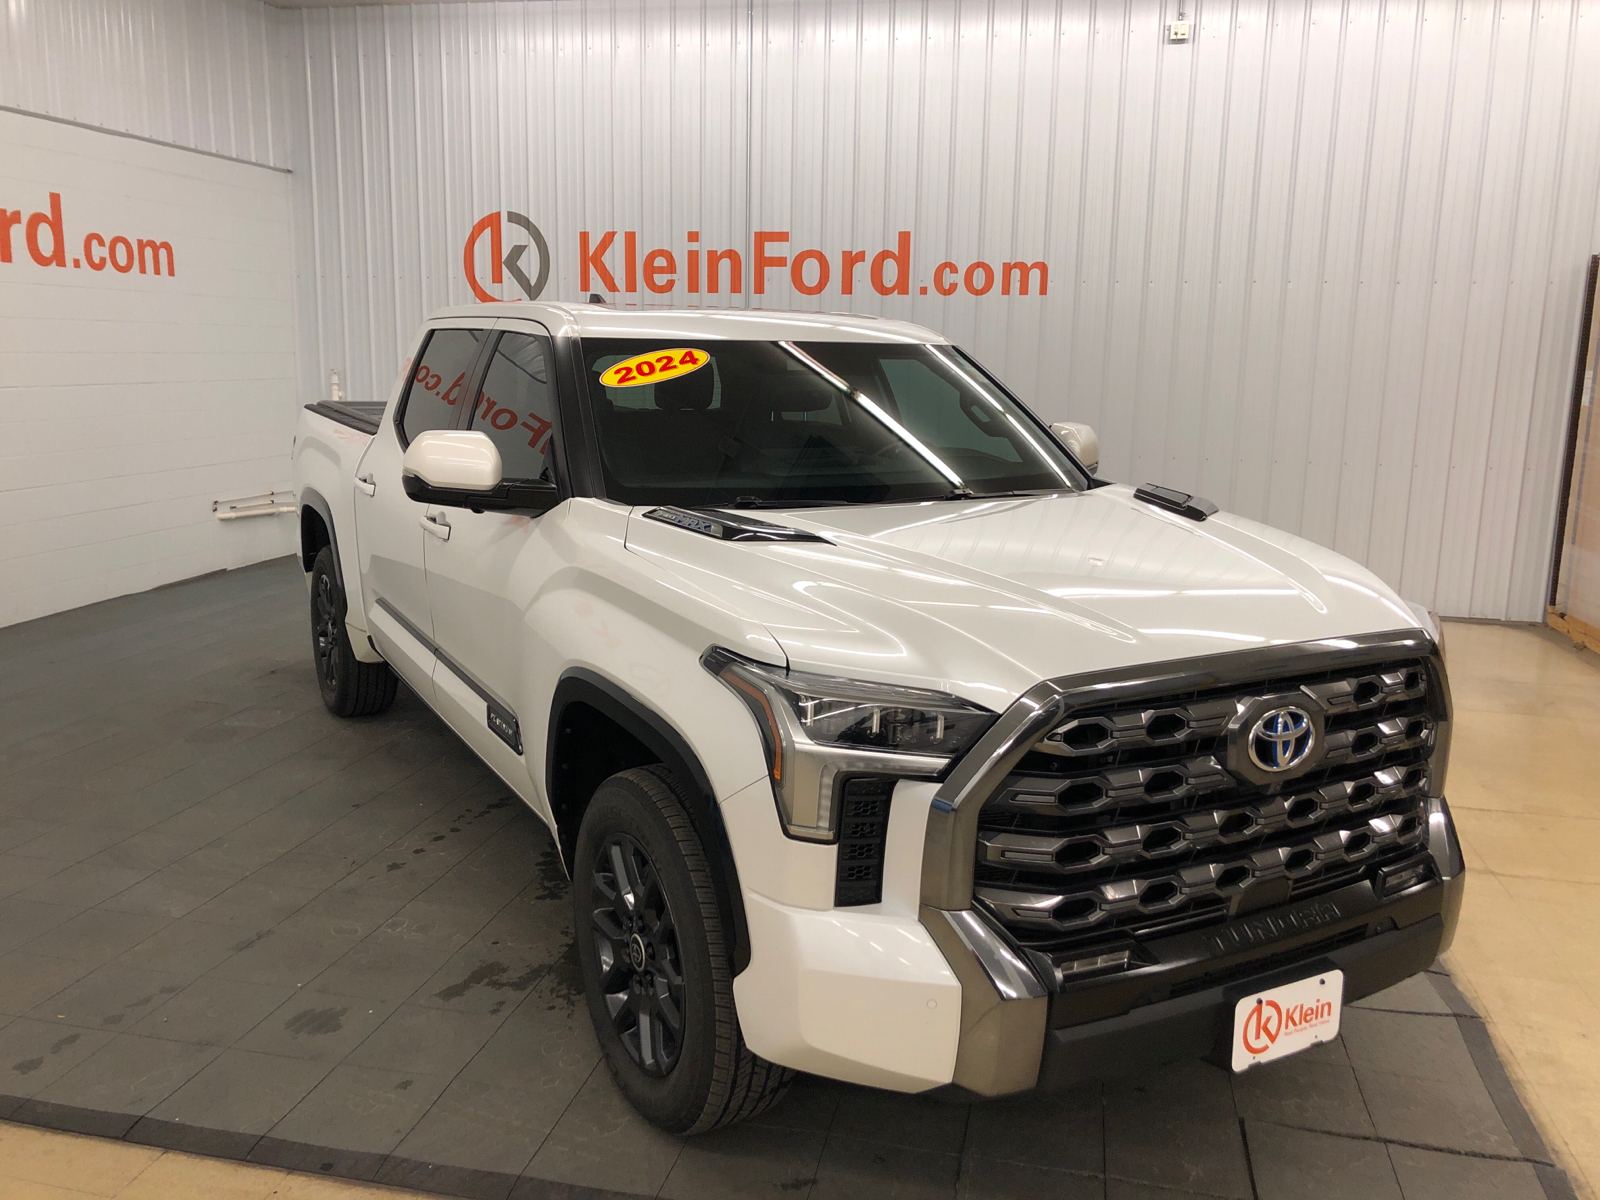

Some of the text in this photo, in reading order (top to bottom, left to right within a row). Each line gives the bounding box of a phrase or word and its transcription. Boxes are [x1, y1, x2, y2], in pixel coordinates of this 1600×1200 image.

[579, 230, 1049, 296] KleinFord.com
[613, 350, 701, 385] 2024
[1285, 998, 1332, 1030] Klein
